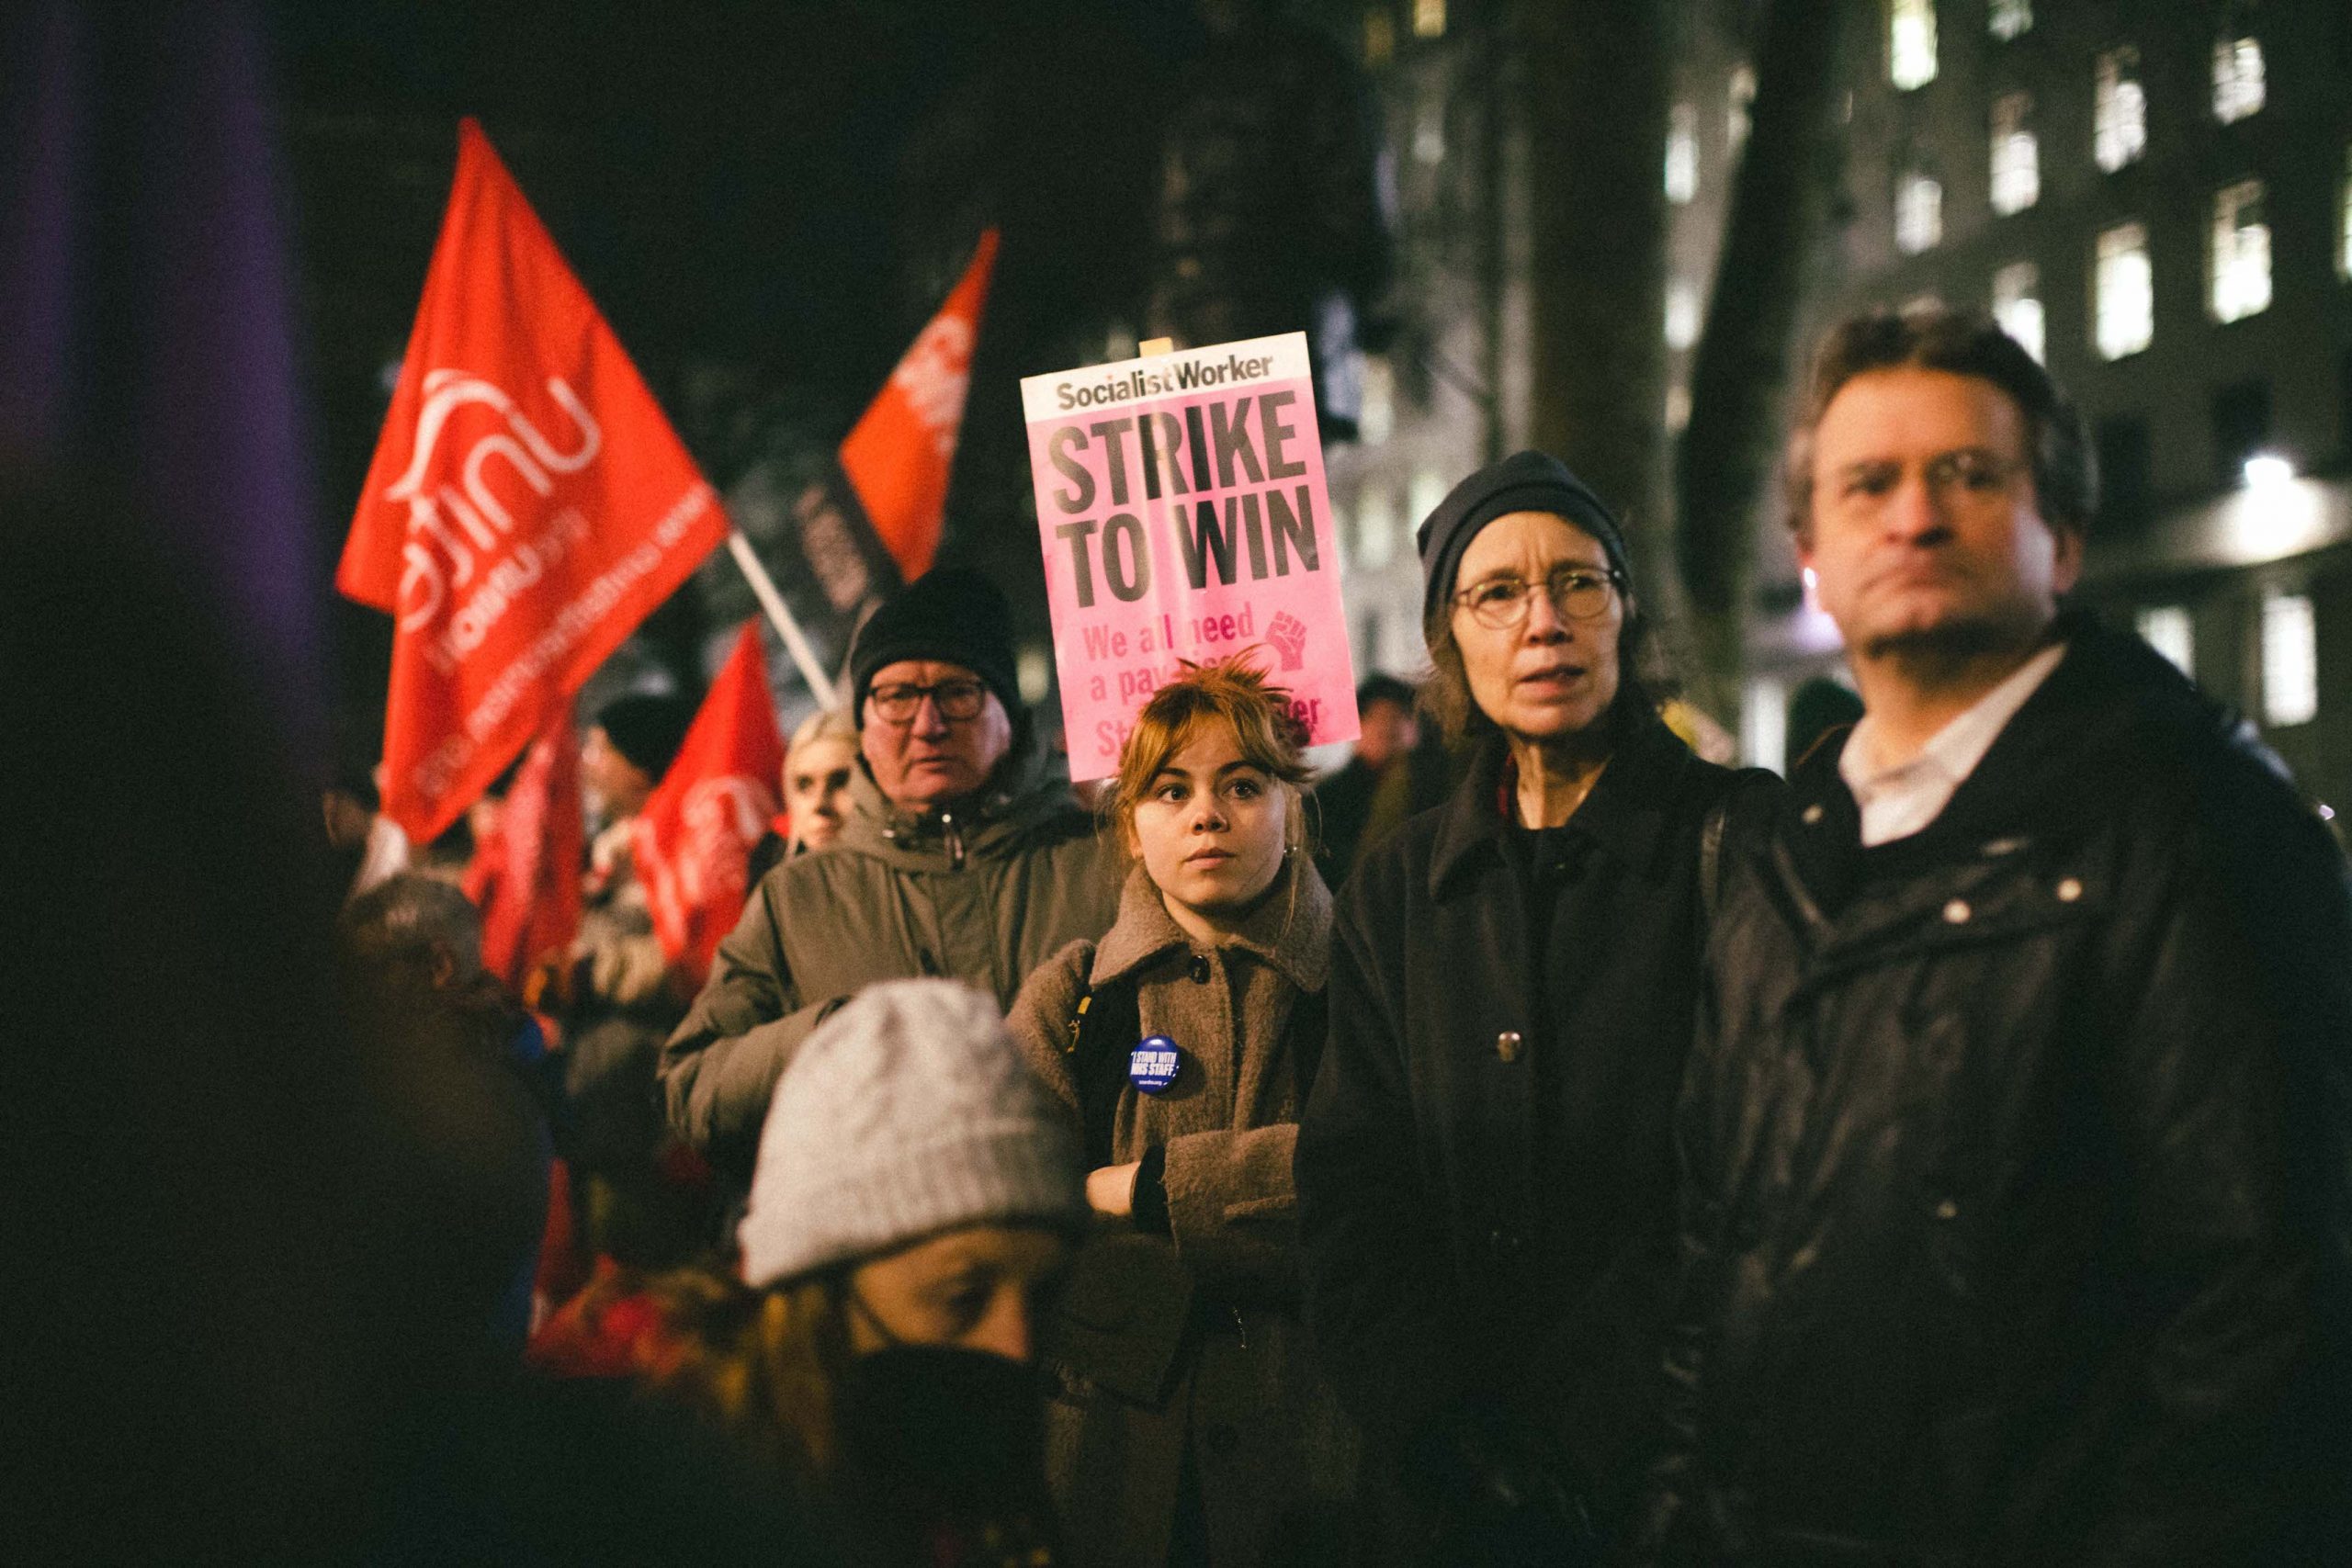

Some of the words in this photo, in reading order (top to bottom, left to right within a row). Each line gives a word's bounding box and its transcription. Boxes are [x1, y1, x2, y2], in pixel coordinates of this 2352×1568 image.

[1057, 370, 1172, 411] Socialist
[1174, 355, 1273, 389] Worker
[1048, 389, 1306, 515] STRIKE
[1056, 513, 1149, 608] TO
[1173, 484, 1320, 590] WIN
[1081, 624, 1127, 660] We
[1191, 601, 1255, 644] need
[1091, 674, 1107, 702] a
[1136, 1051, 1158, 1064] STAND
[1158, 1051, 1177, 1064] WITH
[1148, 1063, 1174, 1076] STAFF
